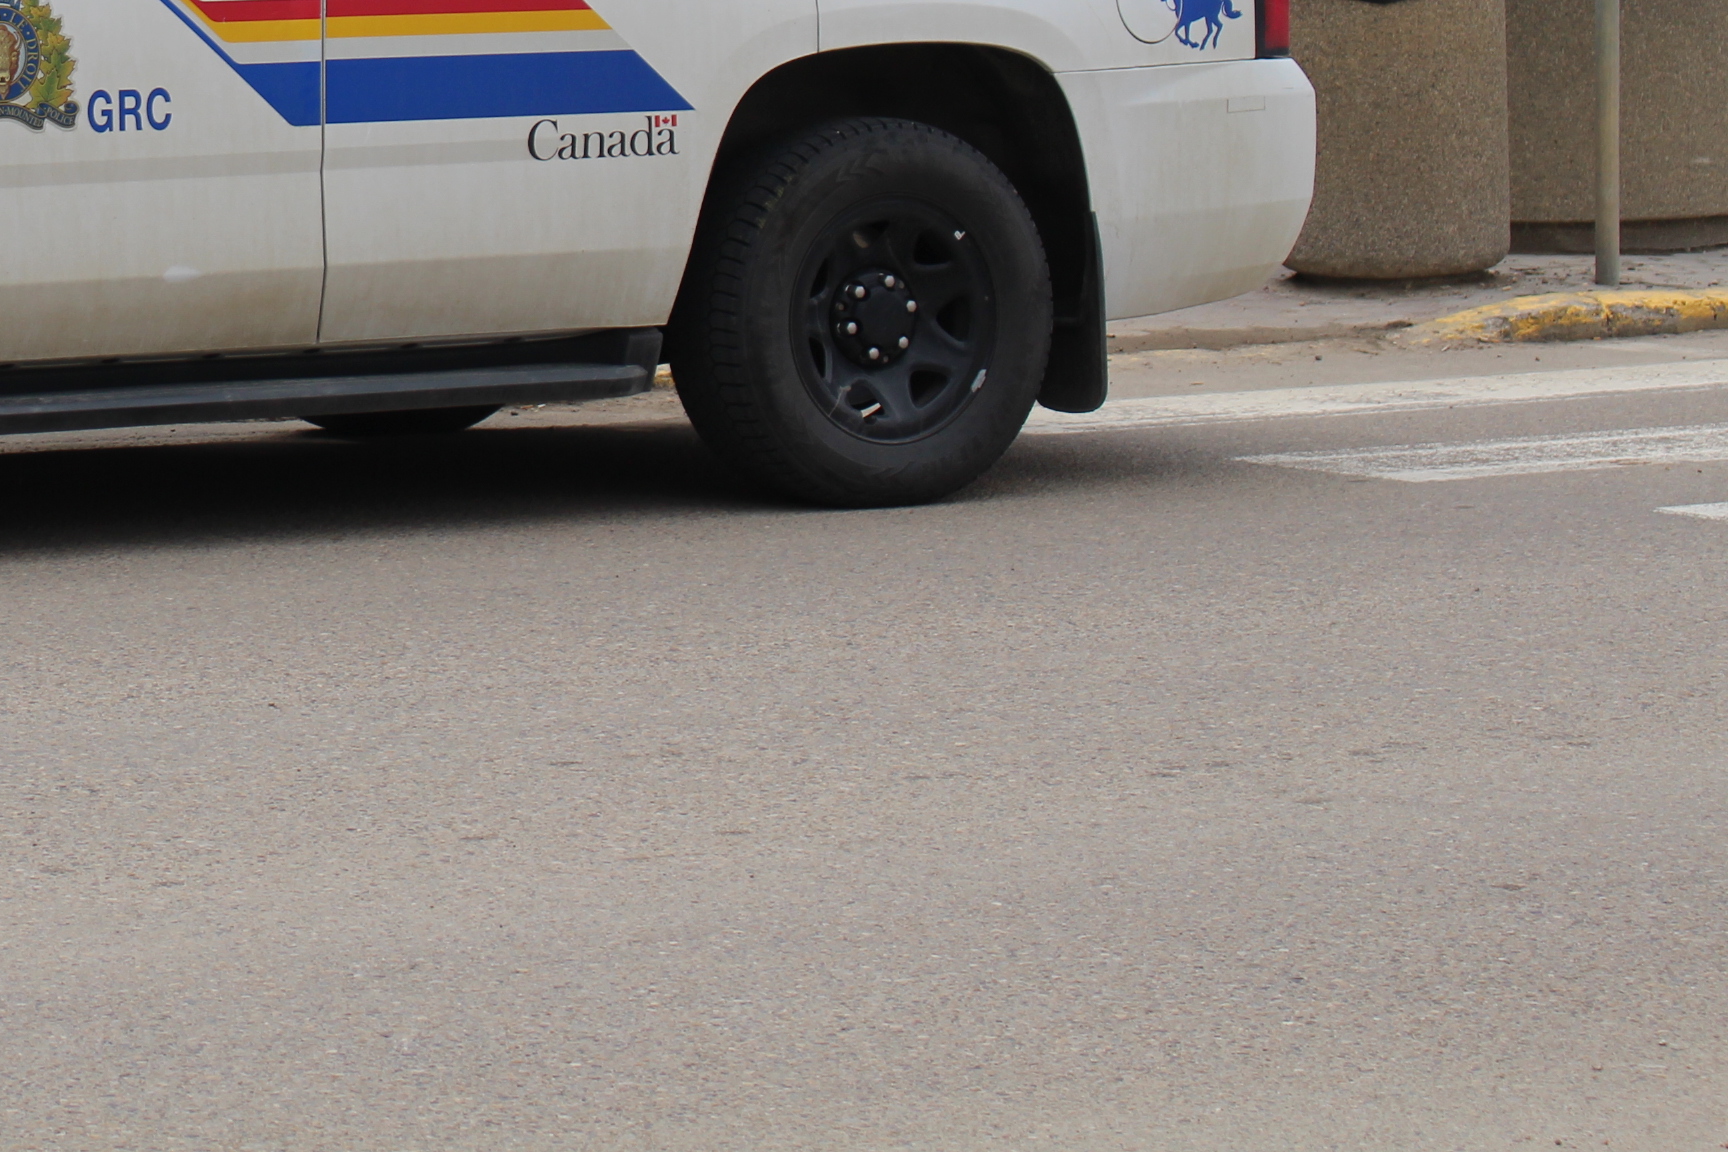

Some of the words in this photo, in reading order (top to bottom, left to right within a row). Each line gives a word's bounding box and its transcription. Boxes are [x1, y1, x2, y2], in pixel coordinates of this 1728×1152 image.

[8, 12, 27, 30] LE
[20, 38, 38, 94] DROIT
[87, 87, 172, 133] GRC
[528, 115, 680, 161] Canada
